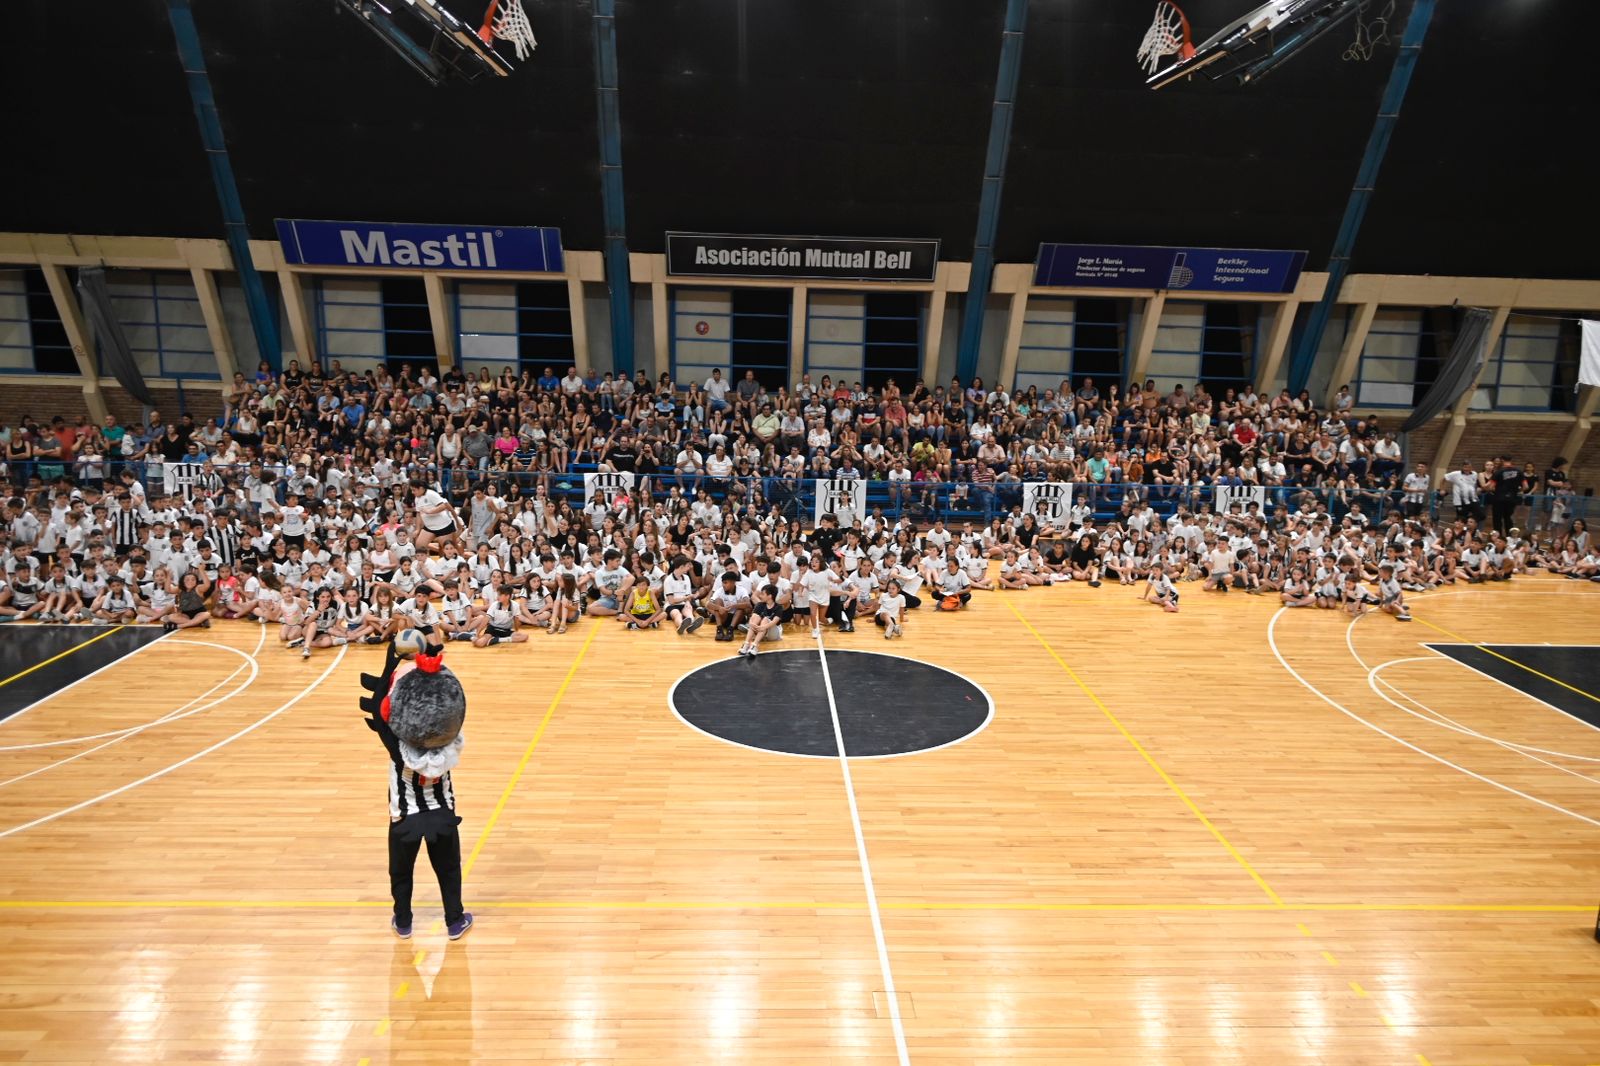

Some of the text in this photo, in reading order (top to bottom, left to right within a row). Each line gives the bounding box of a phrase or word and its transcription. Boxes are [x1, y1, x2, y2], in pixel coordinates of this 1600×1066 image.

[695, 246, 912, 270] Asociación Mutual Bell
[1078, 257, 1095, 265] Jorge
[1217, 257, 1249, 266] Berkley
[1215, 266, 1270, 275] International
[1213, 274, 1245, 284] Seguros
